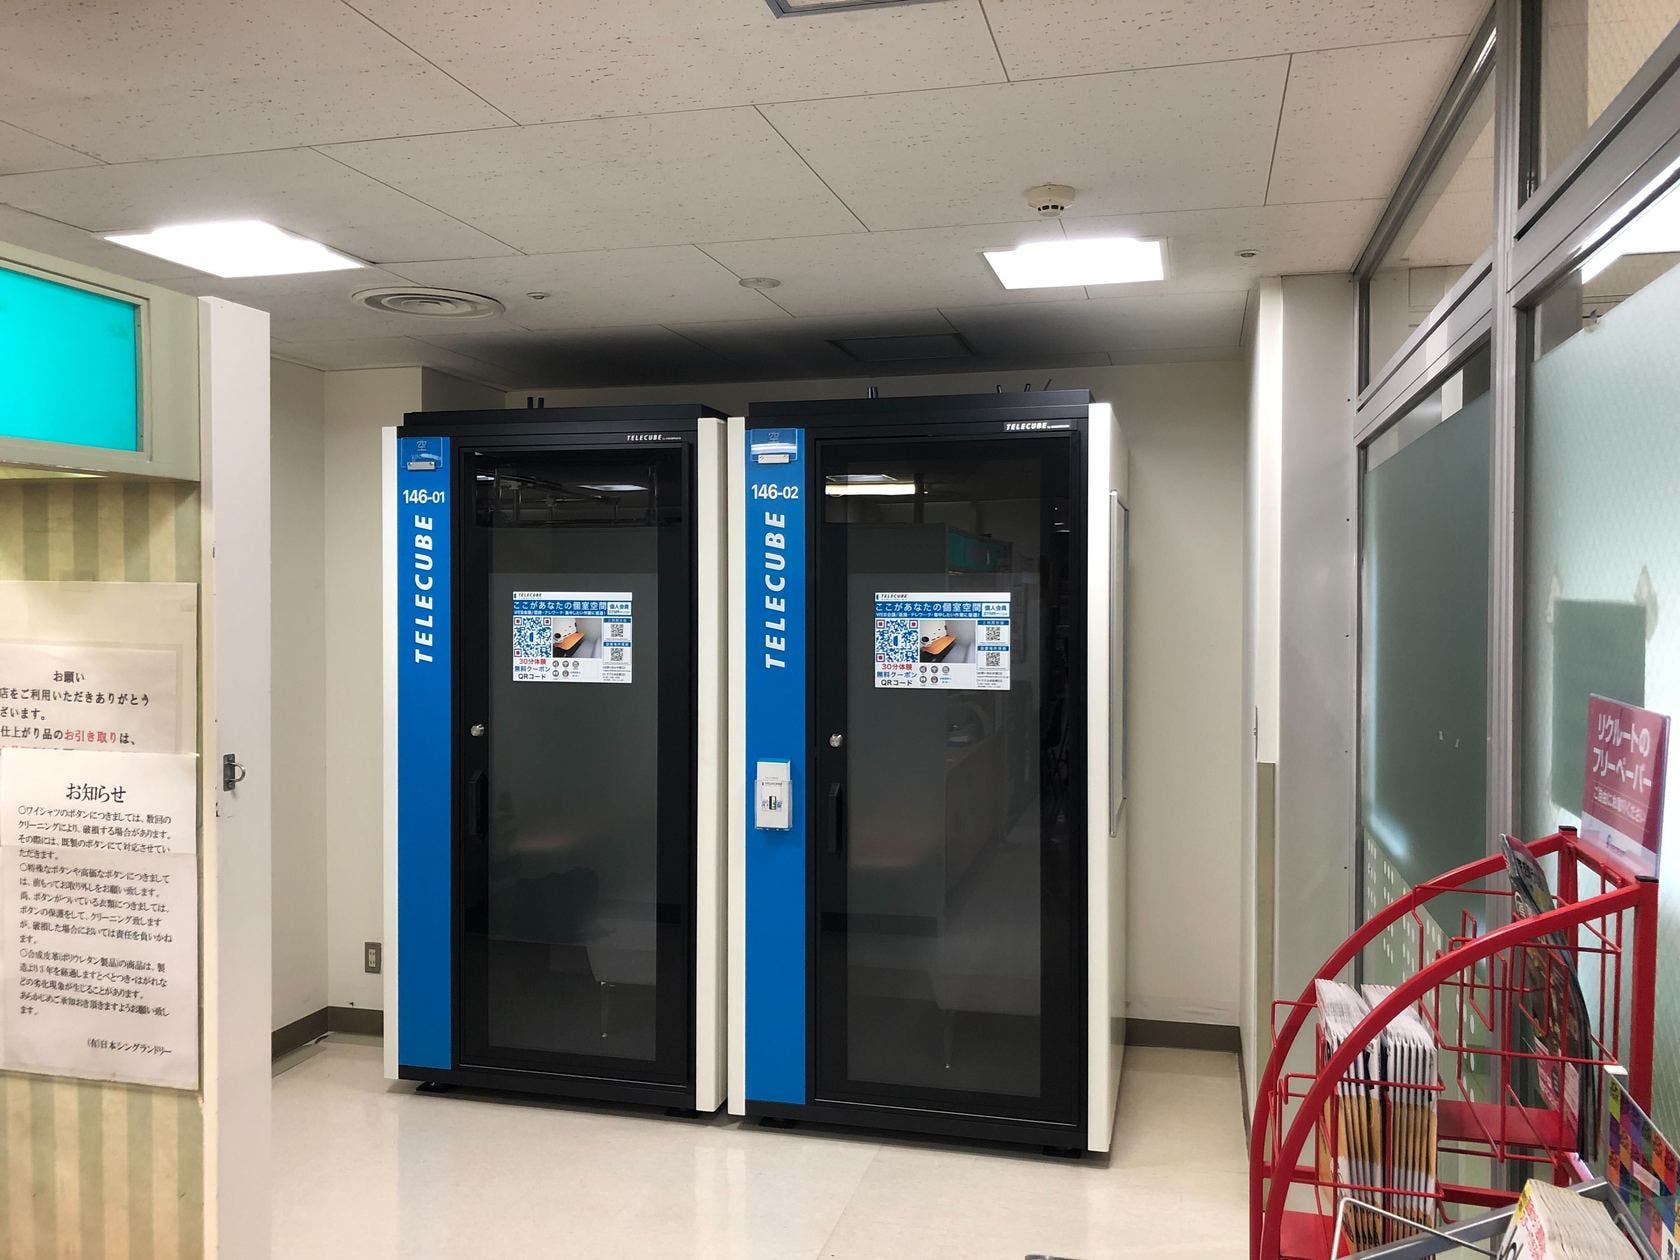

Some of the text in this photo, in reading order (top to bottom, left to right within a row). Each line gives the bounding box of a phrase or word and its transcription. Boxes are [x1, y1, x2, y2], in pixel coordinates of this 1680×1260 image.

[402, 489, 445, 504] 146-01
[751, 483, 799, 500] 146-02
[415, 515, 434, 664] TELECUBE
[765, 511, 786, 669] TELECUBE
[513, 601, 607, 611] ここがあなたの個室空間
[875, 603, 981, 612] ここがあなたの個室空間
[53, 670, 85, 683] お願い
[1598, 713, 1651, 758] リクルートの
[1592, 746, 1652, 793] フリーペーパー
[65, 783, 127, 803] お知らせ
